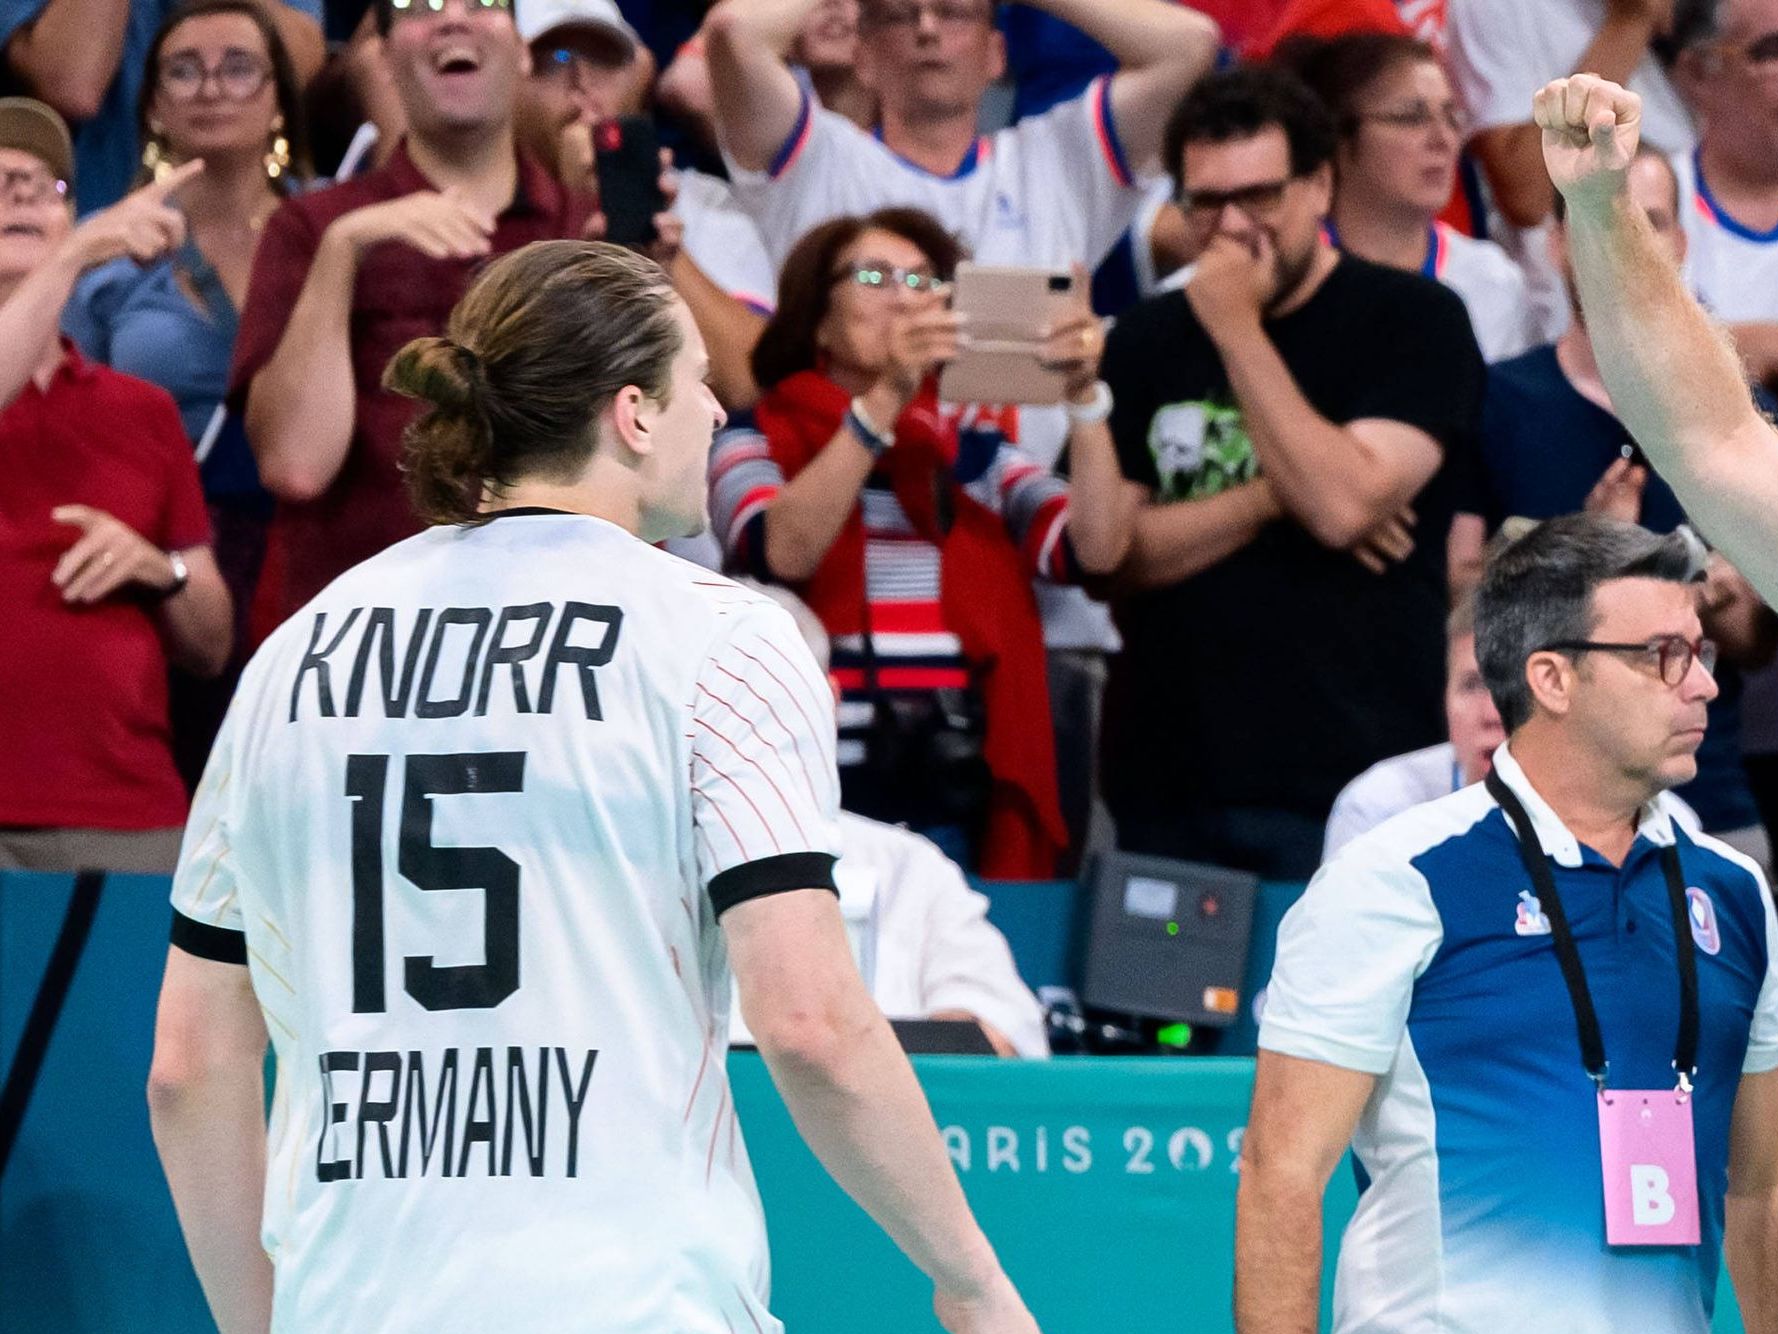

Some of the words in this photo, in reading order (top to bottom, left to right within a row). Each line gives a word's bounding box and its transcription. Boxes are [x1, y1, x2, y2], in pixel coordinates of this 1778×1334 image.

[290, 602, 624, 723] KNORR
[345, 751, 527, 1014] 15
[317, 1046, 599, 1182] ERMANY
[1630, 1164, 1675, 1225] B
